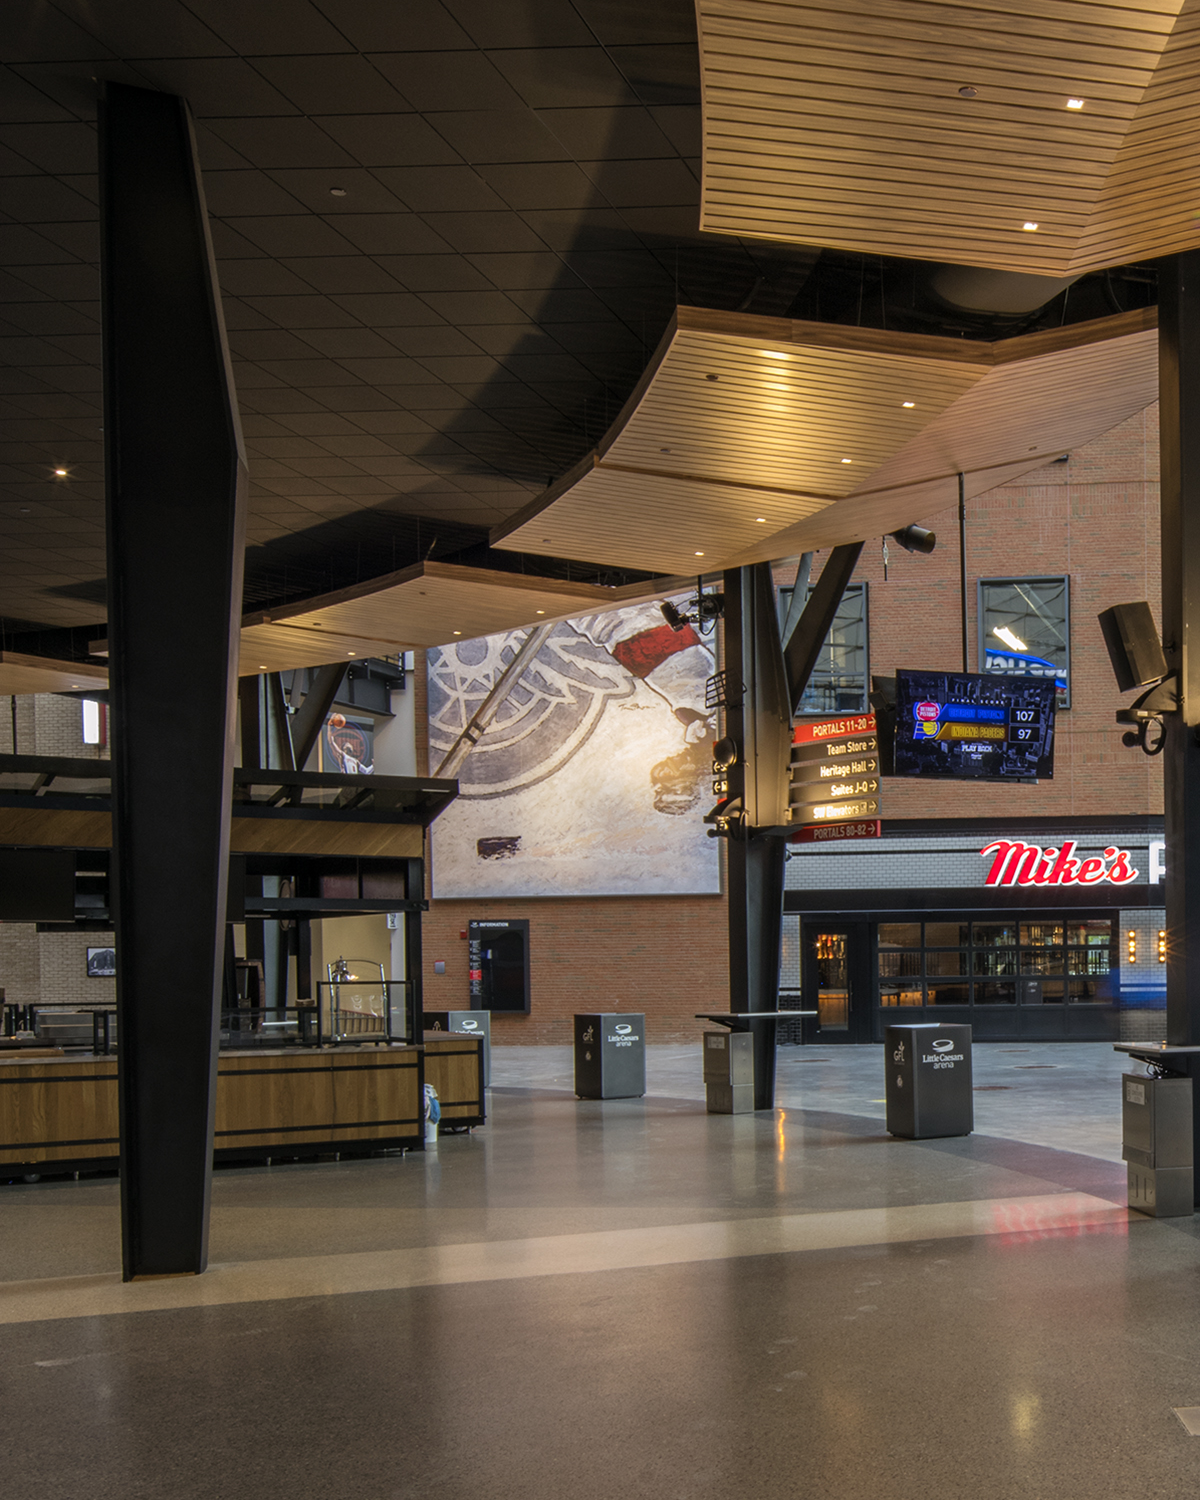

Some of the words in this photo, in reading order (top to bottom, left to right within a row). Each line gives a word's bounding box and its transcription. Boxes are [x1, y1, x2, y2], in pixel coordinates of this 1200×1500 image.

[1016, 710, 1035, 722] 107
[812, 721, 846, 737] PORTALS
[846, 717, 867, 732] 11-20
[951, 726, 979, 738] INDIANA
[980, 727, 1006, 739] PACERS
[1018, 728, 1032, 740] 97
[826, 743, 847, 756] Team
[847, 741, 867, 753] Store
[820, 764, 851, 777] Heritage
[851, 760, 867, 773] Hall
[830, 783, 854, 797] Suites
[854, 781, 868, 794] J-Q
[813, 806, 826, 819] SW
[826, 804, 859, 818] Elevators
[813, 826, 846, 839] PORTALS
[846, 823, 867, 836] 80-82
[979, 839, 1139, 887] Mike's
[922, 1054, 940, 1063] Little
[940, 1053, 964, 1062] Caesars
